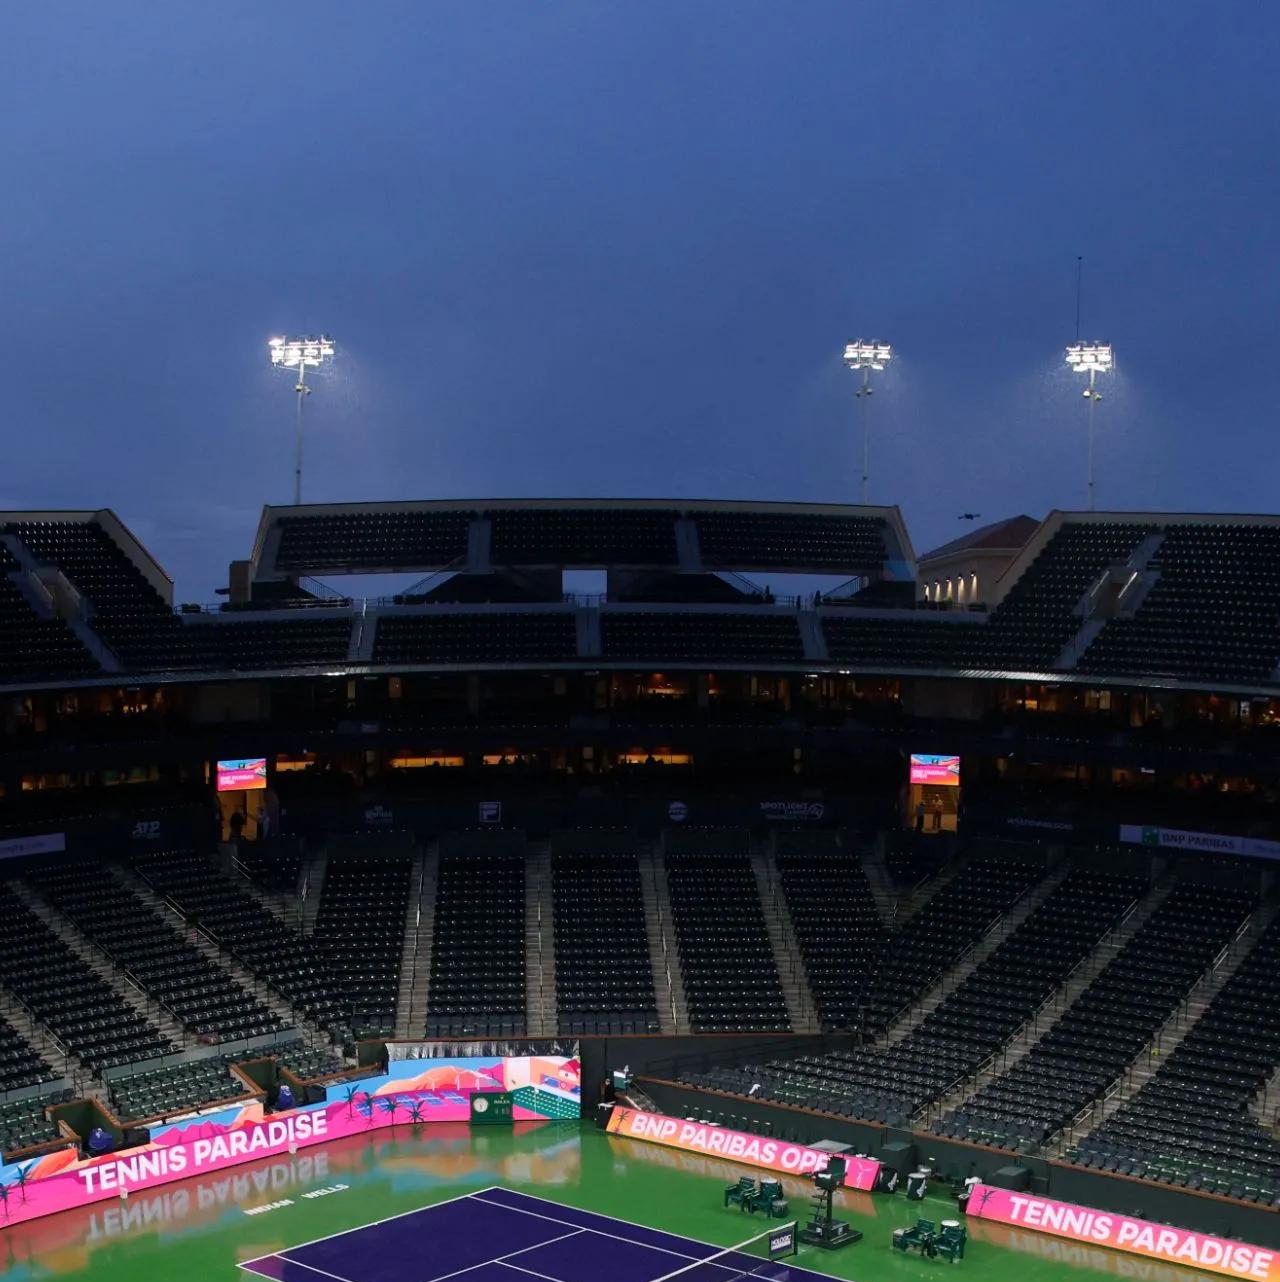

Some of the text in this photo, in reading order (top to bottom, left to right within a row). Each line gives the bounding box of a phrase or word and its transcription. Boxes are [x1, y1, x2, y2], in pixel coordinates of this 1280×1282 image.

[1162, 833, 1236, 850] BNP PARIBAS
[79, 1110, 328, 1194] TENNIS PARADISE
[630, 1113, 849, 1173] BNP PARIBAS OPE
[243, 1183, 350, 1215] INDIAN WELLS
[1009, 1195, 1274, 1278] TENNIS PARADISE
